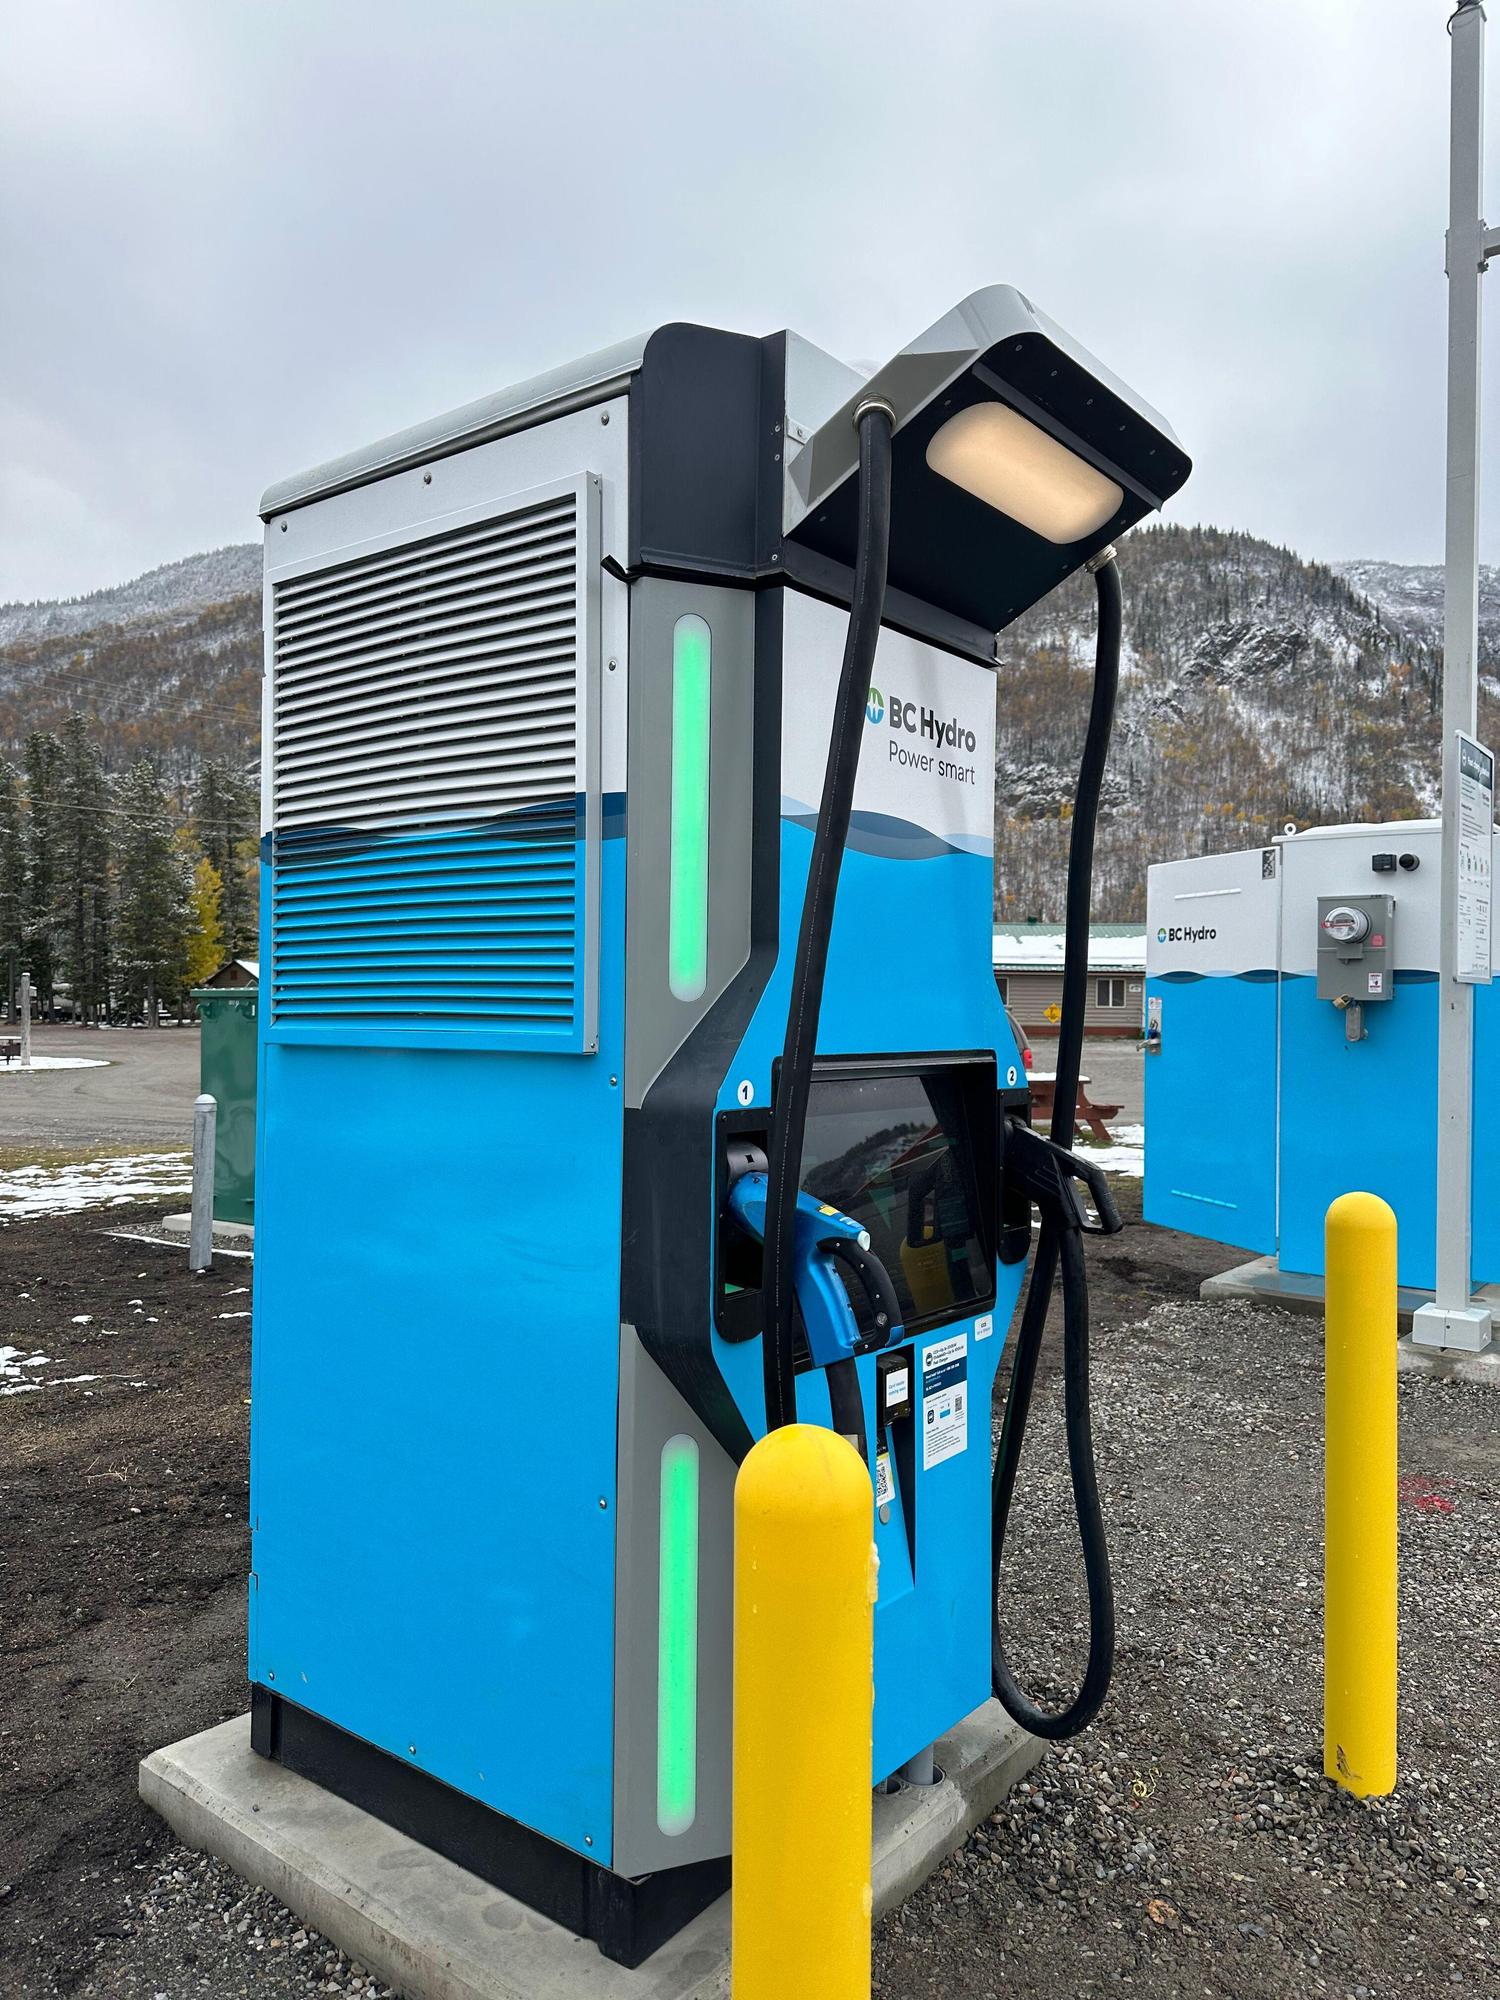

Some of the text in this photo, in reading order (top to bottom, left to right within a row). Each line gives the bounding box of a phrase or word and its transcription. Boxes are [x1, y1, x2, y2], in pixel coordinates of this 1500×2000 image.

[890, 695, 976, 753] BC Hydro
[889, 739, 976, 785] Power smart
[1168, 925, 1217, 943] BC Hydro
[1009, 1070, 1015, 1081] 2
[742, 1085, 748, 1100] 1
